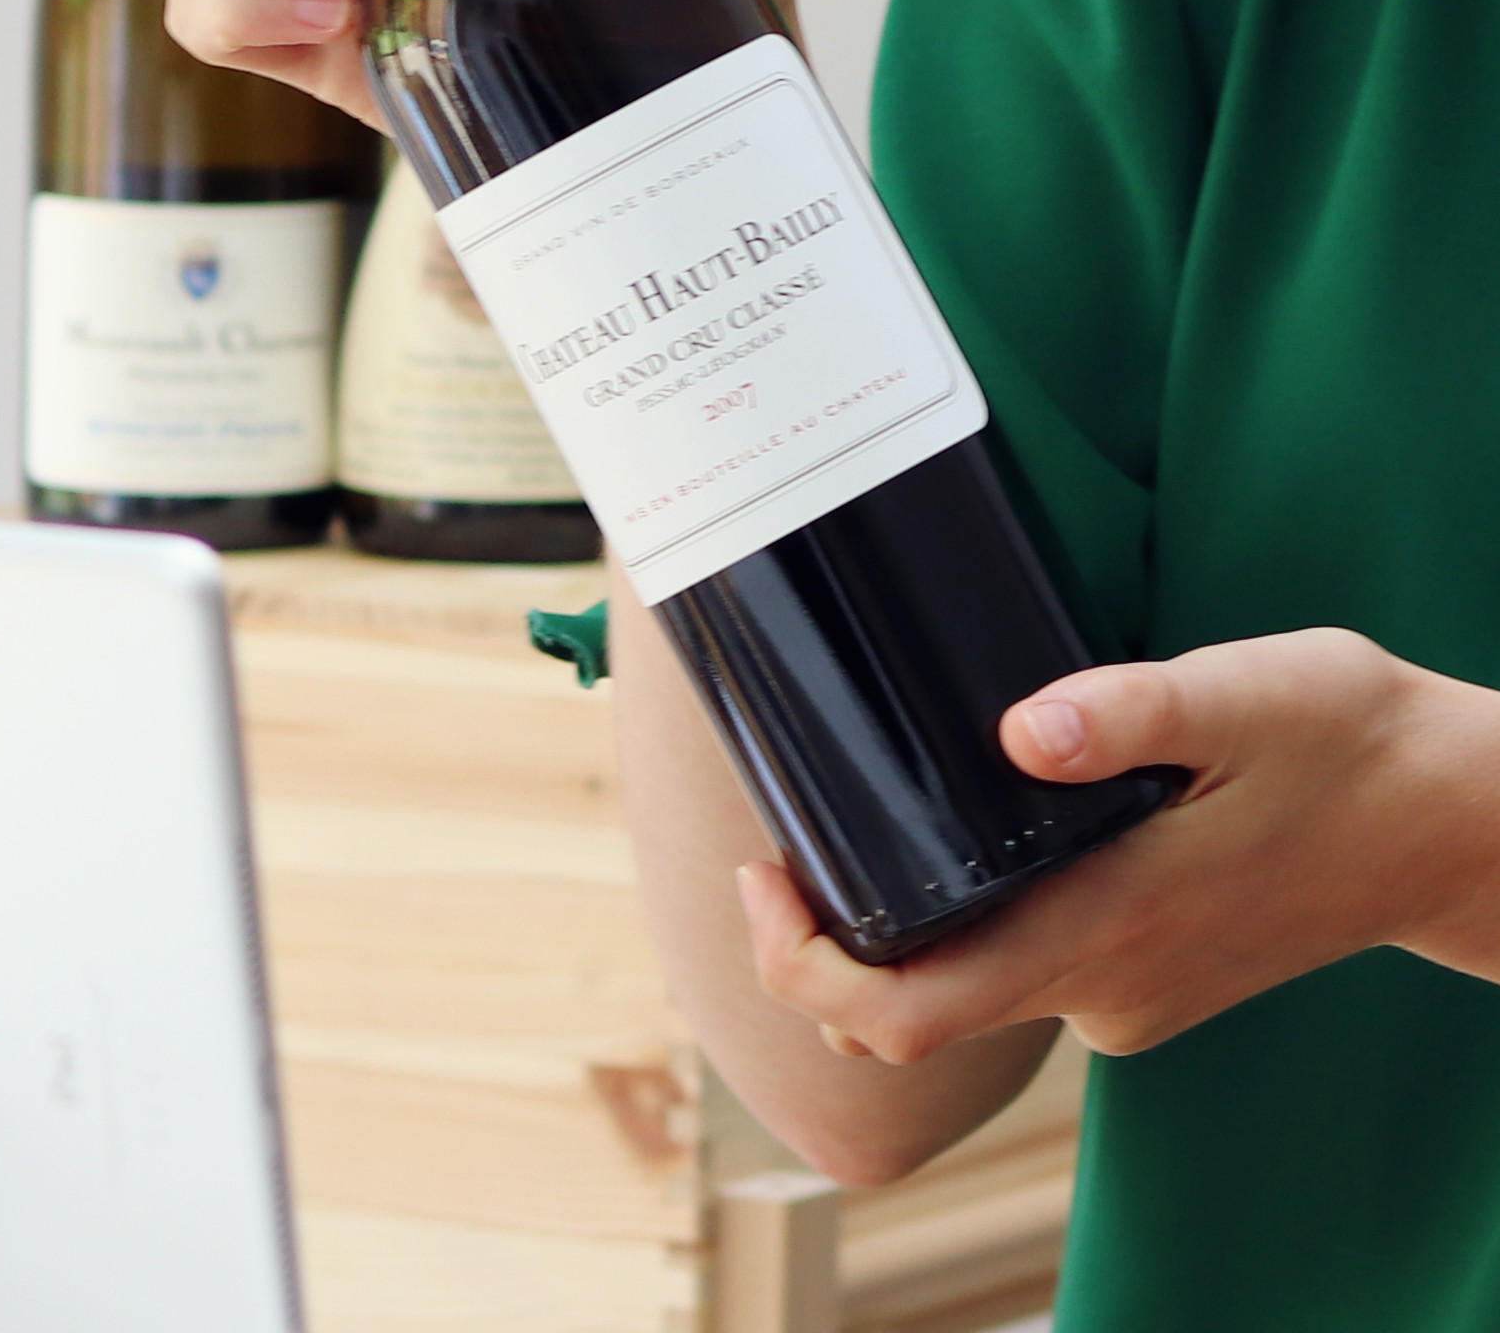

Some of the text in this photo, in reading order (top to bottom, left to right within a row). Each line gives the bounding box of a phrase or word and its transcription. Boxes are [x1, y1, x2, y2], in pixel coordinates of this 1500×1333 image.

[609, 195, 642, 218] DE
[645, 136, 752, 199] BORDEAUX
[626, 191, 845, 324] HAUT-BAILLY
[583, 263, 826, 408] GRAND CRU CLASSÉ
[701, 381, 758, 422] 2007
[676, 434, 785, 497] BOUTEILLE
[790, 415, 819, 436] AU
